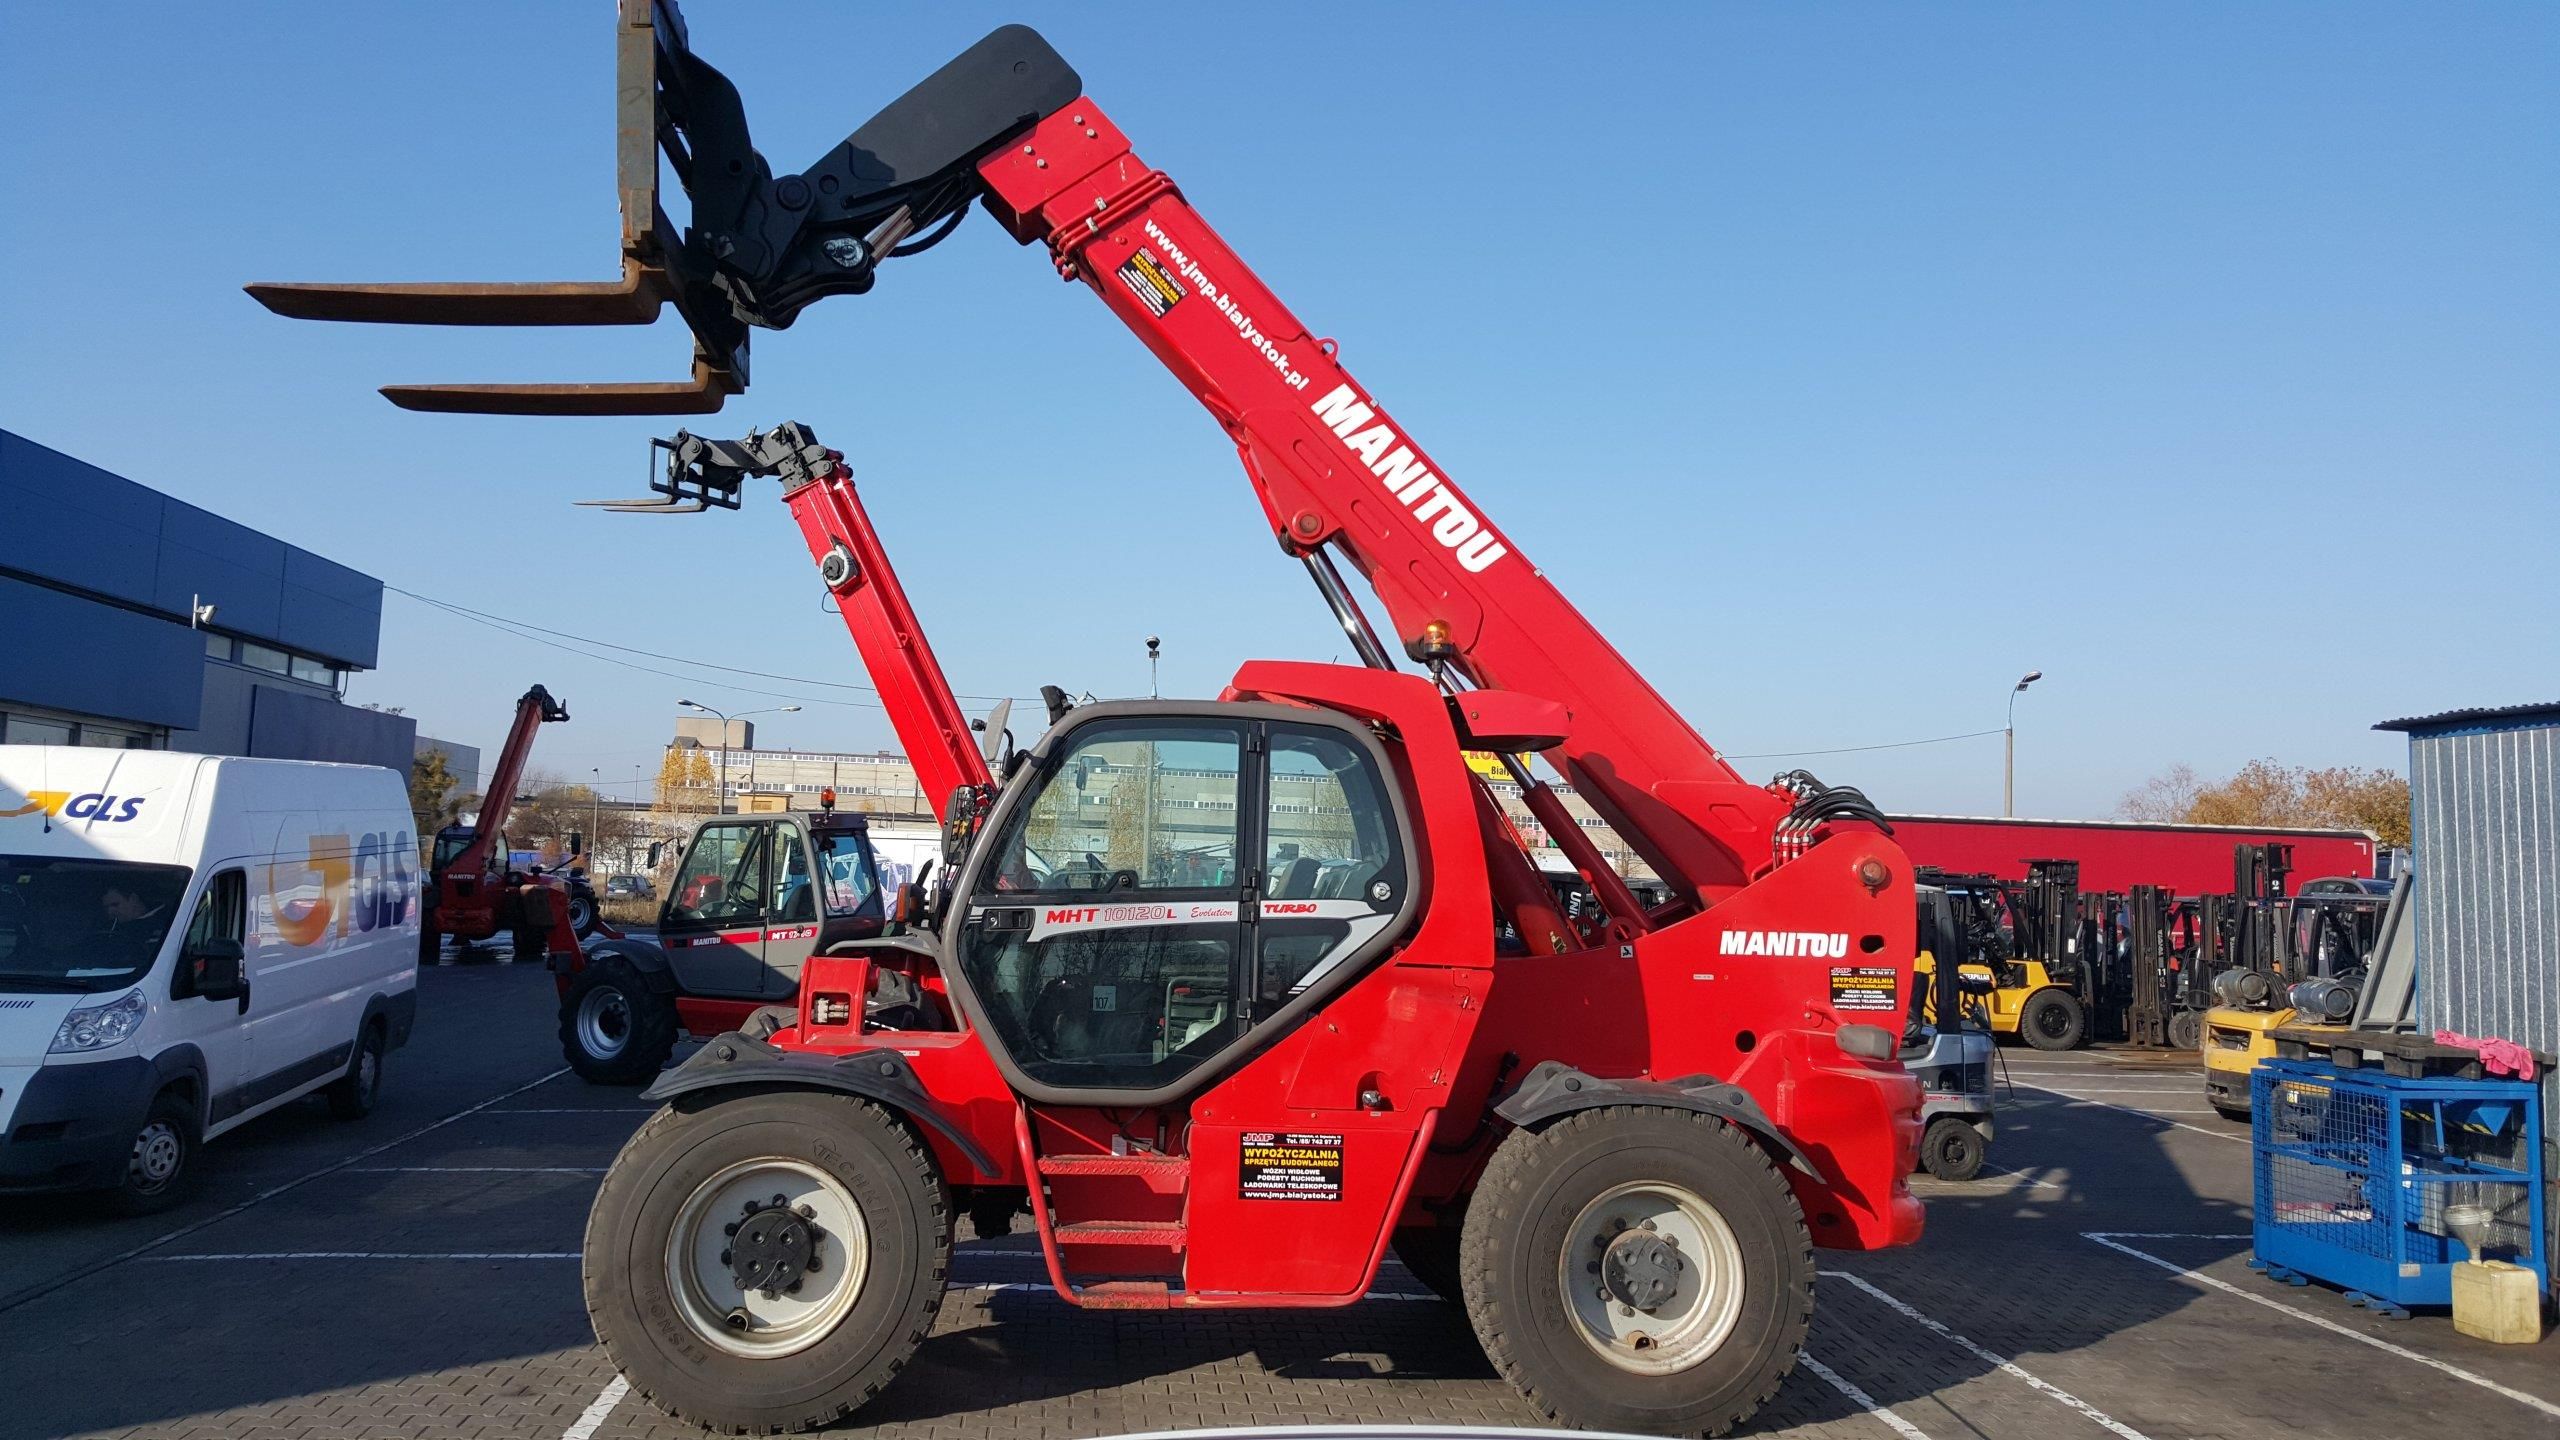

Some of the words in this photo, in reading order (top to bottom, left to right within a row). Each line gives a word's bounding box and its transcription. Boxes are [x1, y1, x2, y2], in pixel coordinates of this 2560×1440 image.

[1144, 218, 1310, 391] www.jmp.bialystok.pl
[1310, 383, 1508, 573] MANITOU
[65, 793, 146, 823] GLS
[355, 830, 408, 932] GLS
[1046, 908, 1100, 924] MHT
[1190, 906, 1233, 918] Evolution
[1264, 903, 1317, 914] TURBO
[692, 937, 722, 946] MANITOU
[772, 932, 787, 940] MT
[1719, 930, 1849, 959] MANITOU
[1243, 1133, 1274, 1142] JMP
[1244, 1148, 1339, 1159] WYPOŻYCZALNIA
[1245, 1192, 1337, 1200] www.jmp.bialystok.pl
